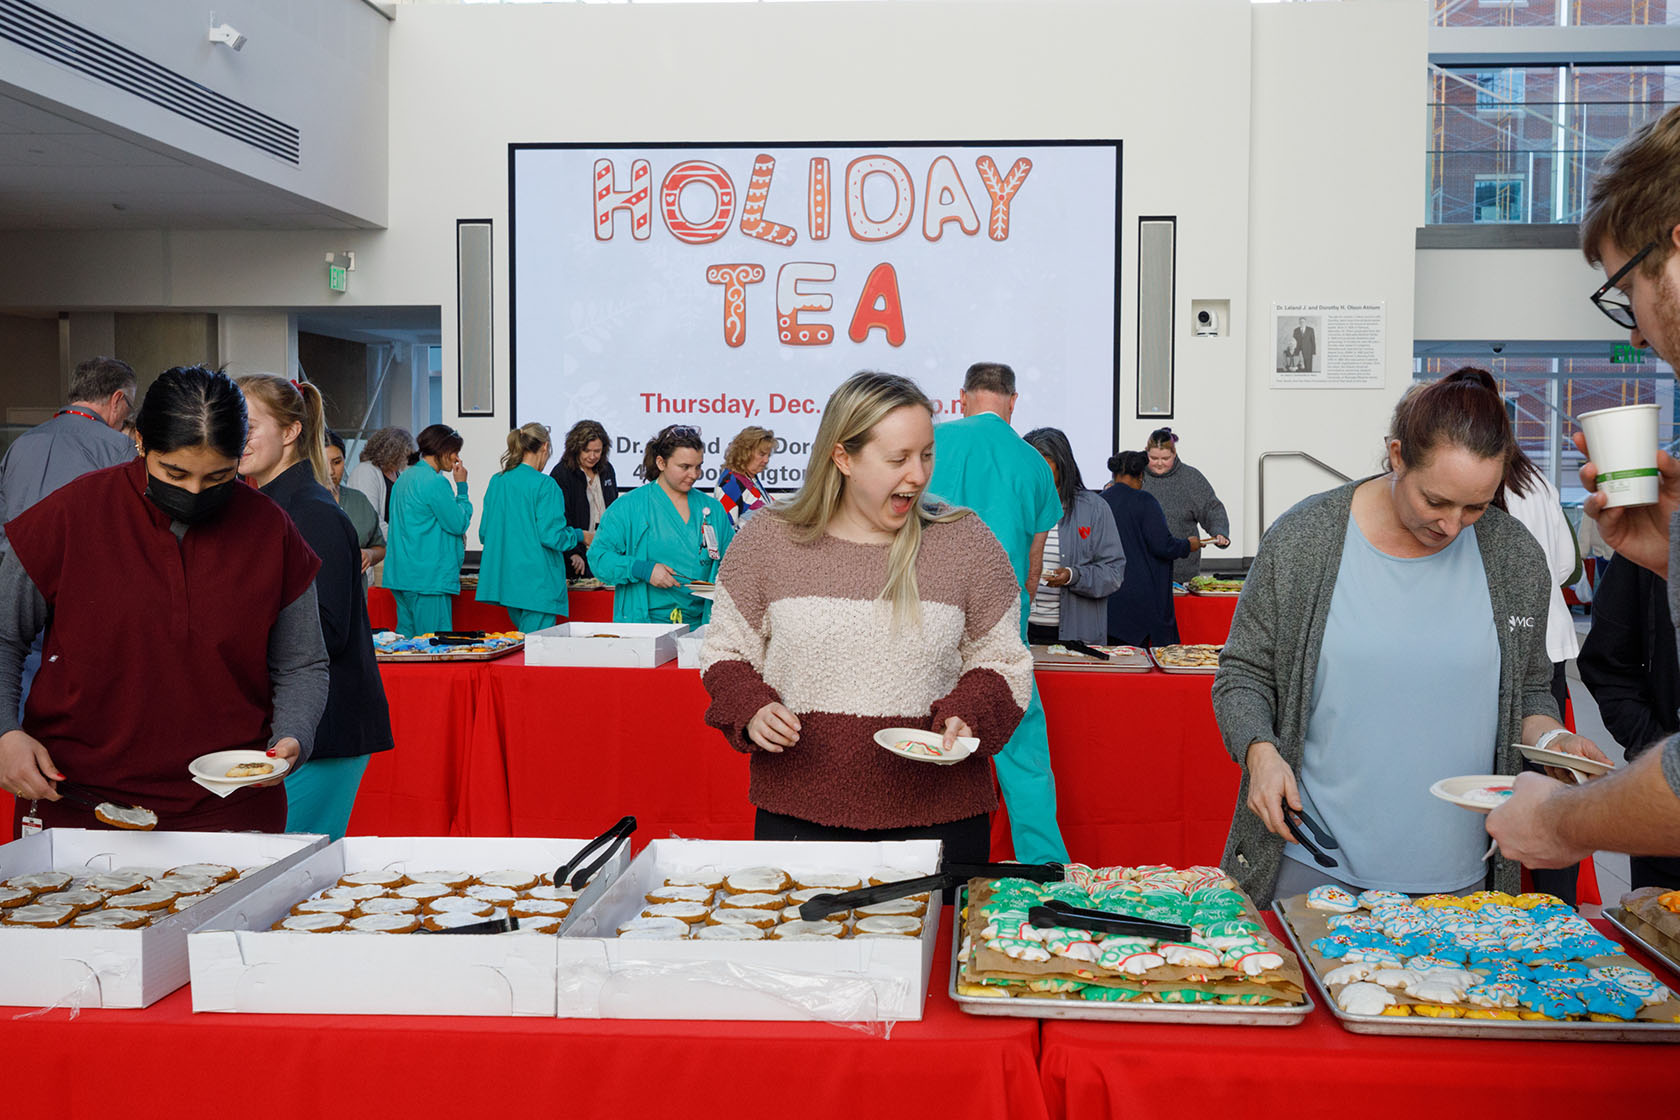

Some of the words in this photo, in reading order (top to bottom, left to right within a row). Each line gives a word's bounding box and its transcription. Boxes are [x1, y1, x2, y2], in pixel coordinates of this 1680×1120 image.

[592, 153, 1033, 246] HOLIDAY
[705, 261, 906, 347] TEA
[640, 393, 760, 418] Thursday,
[769, 393, 820, 414] Dec.
[617, 436, 643, 453] Dr.
